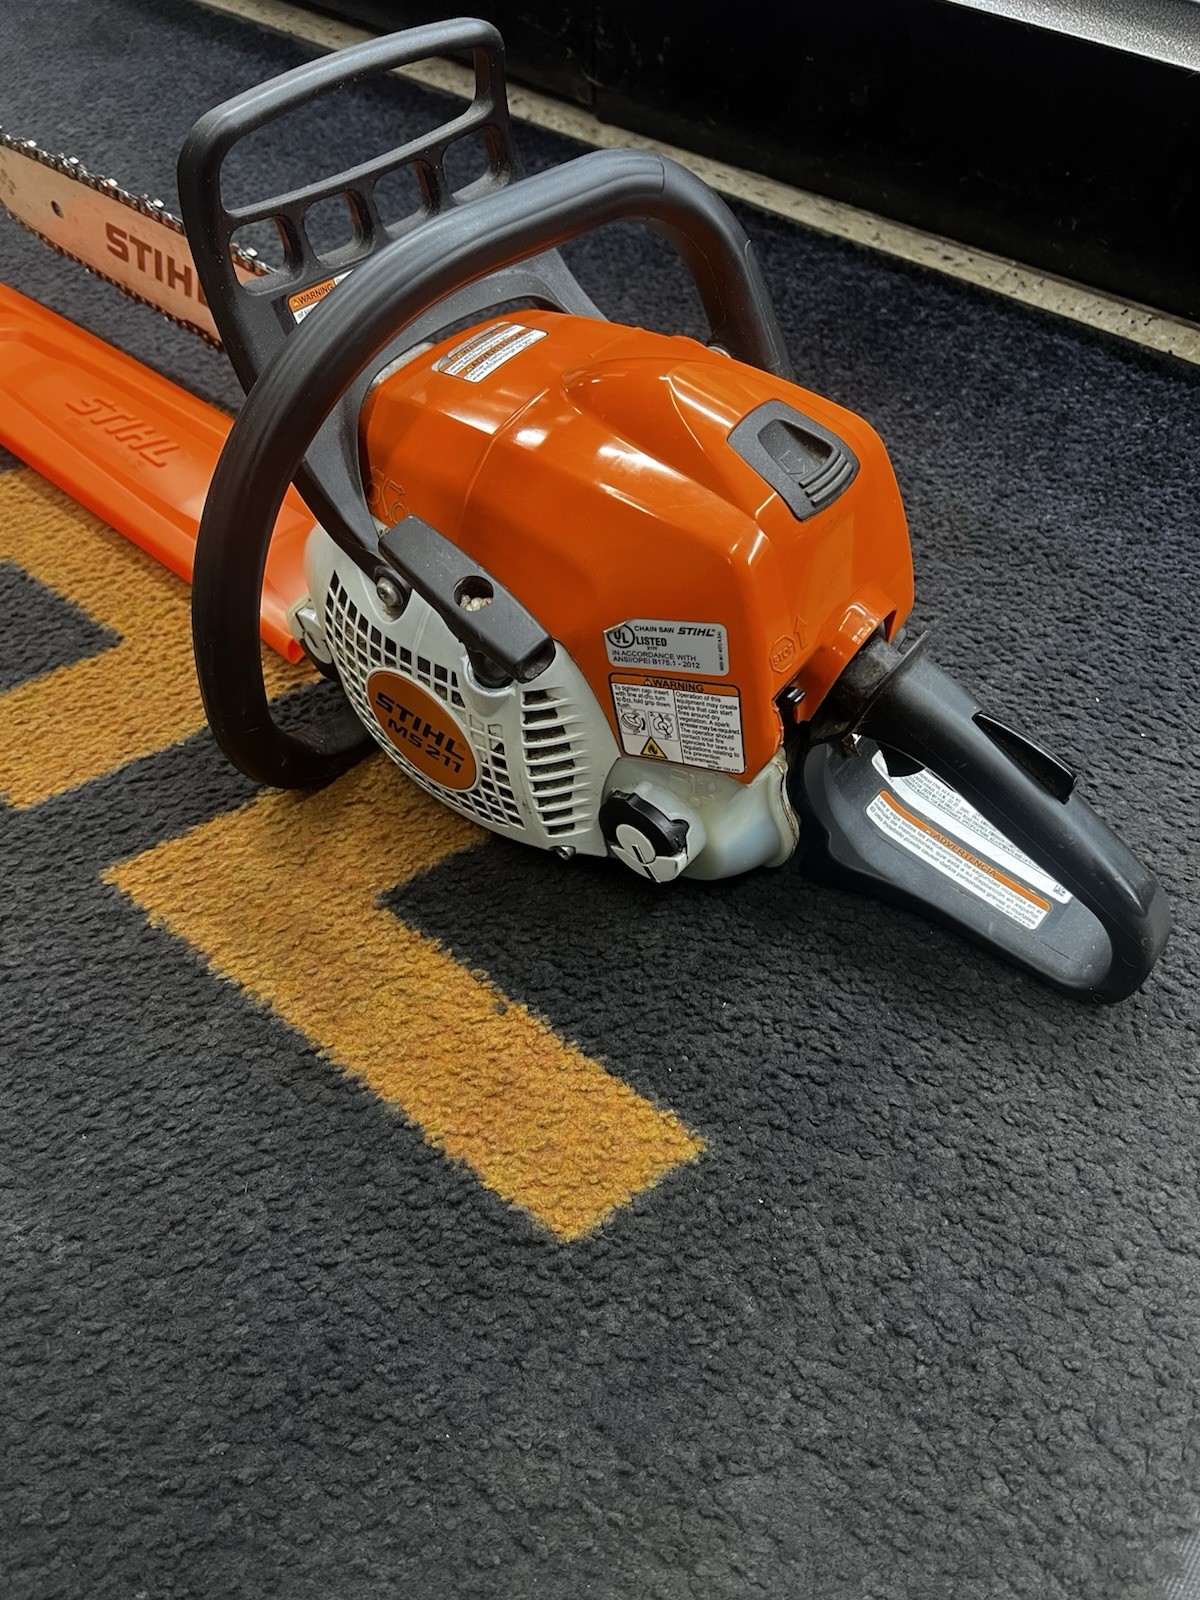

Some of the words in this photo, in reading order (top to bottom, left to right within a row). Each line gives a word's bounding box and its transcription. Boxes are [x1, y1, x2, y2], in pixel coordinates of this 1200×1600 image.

[298, 284, 333, 304] WARNING
[65, 395, 182, 469] STIHL
[678, 627, 713, 636] STIHL
[636, 637, 667, 646] LISTED
[621, 650, 674, 659] ACCORDANCE
[773, 643, 792, 666] STOP
[653, 679, 704, 692] WARNING
[676, 691, 703, 700] Operation
[677, 699, 705, 707] equipment
[376, 692, 464, 761] STIHL
[388, 718, 423, 748] MS
[425, 744, 462, 773] 211
[683, 745, 711, 753] regulations
[713, 749, 733, 757] relating
[685, 756, 719, 765] requirements.
[693, 752, 720, 760] prevention
[869, 805, 875, 813] El
[874, 810, 884, 822] uso
[903, 835, 921, 851] puede
[920, 847, 939, 863] causar
[938, 859, 957, 874] daños
[956, 871, 987, 894] personales
[986, 891, 1006, 906] graves
[872, 801, 891, 821] manual
[889, 818, 898, 827] de
[935, 850, 946, 860] que
[945, 857, 960, 869] está
[965, 869, 974, 878] su
[973, 875, 1006, 898] disposición
[1005, 895, 1014, 904] en
[876, 796, 886, 808] Lea
[889, 809, 902, 822] siga
[900, 819, 917, 833] todas
[916, 830, 926, 840] las
[925, 837, 964, 864] precauciones
[963, 861, 972, 870] de
[971, 867, 1001, 888] seguridad
[1000, 885, 1027, 905] incluidas
[1027, 903, 1036, 911] en
[933, 833, 997, 877] ADVERTENCIA
